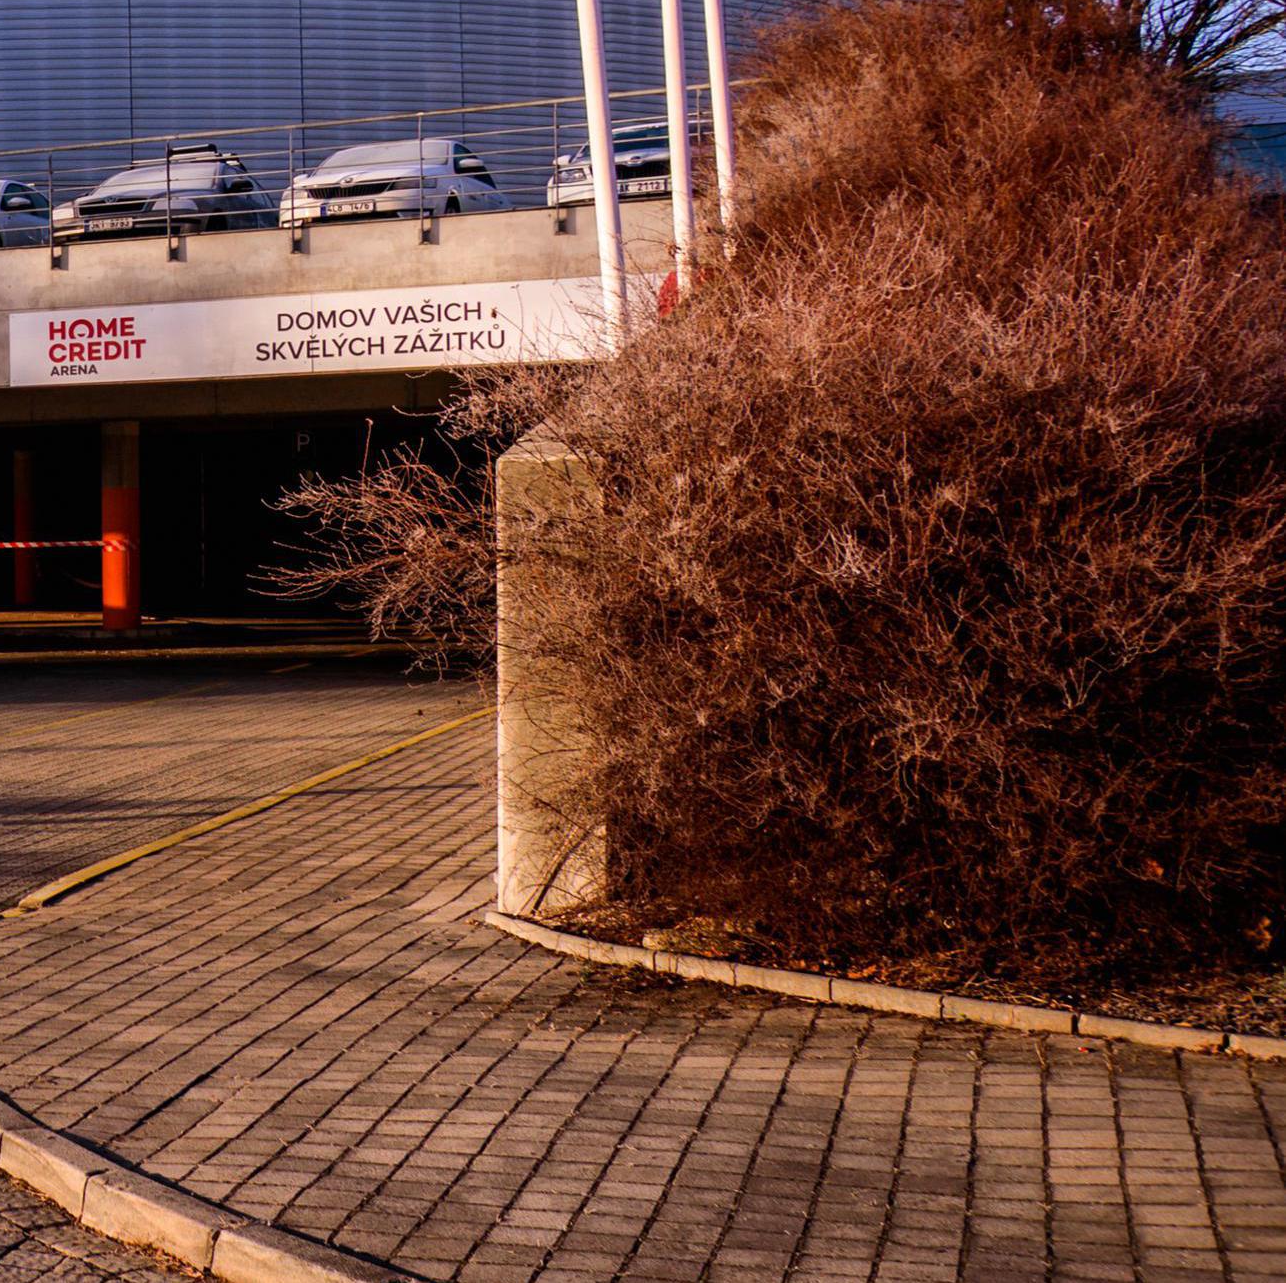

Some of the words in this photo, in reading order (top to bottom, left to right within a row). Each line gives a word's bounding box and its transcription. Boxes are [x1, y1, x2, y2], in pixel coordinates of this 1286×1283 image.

[637, 181, 661, 191] 2112
[276, 308, 376, 332] DOMOV
[384, 299, 482, 325] VAŠICH
[49, 317, 135, 341] HOME
[48, 339, 147, 363] CREDIT
[255, 333, 385, 362] SKVĚLÝCH
[394, 323, 506, 354] ZÁŽITKŮ
[50, 364, 98, 377] ARENA
